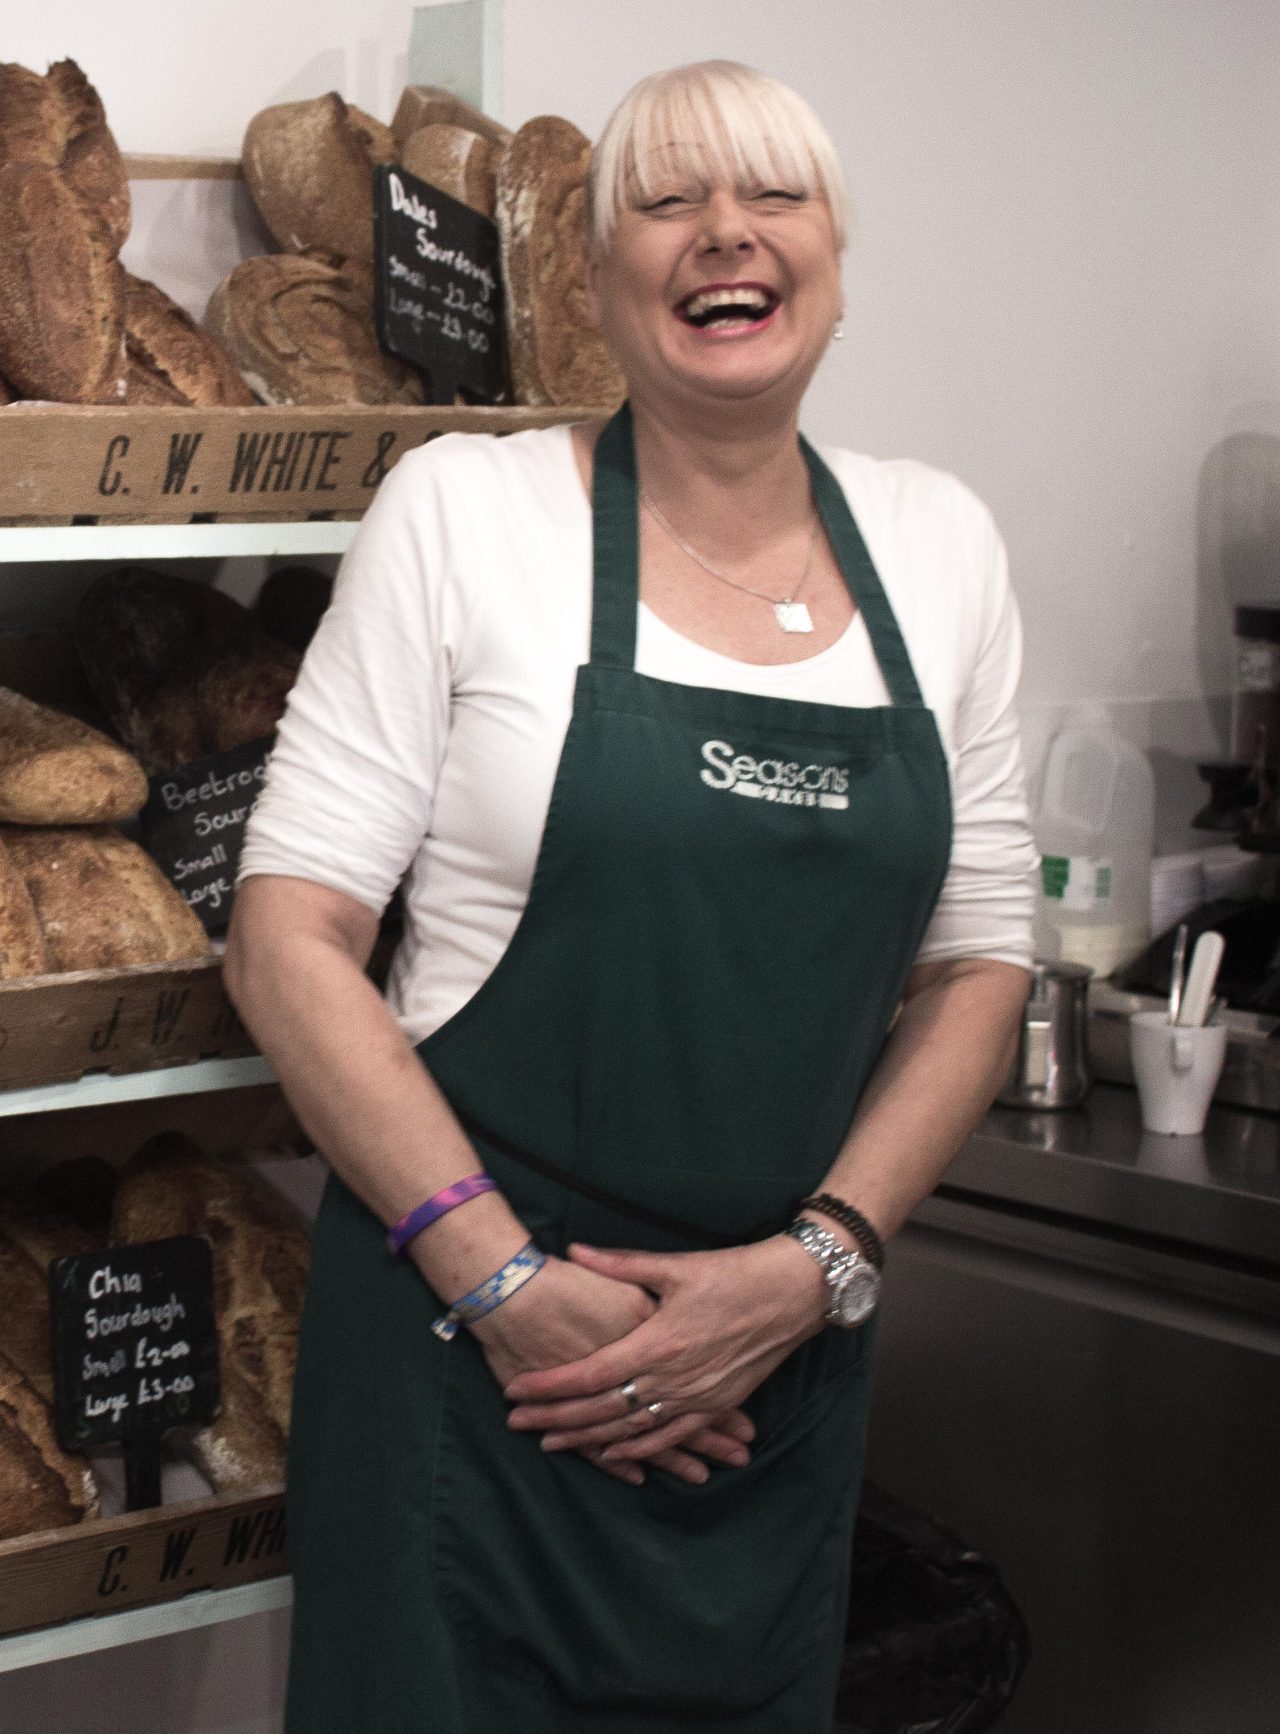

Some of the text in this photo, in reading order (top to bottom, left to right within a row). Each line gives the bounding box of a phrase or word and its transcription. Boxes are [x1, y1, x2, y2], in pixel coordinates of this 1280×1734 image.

[98, 431, 396, 496] C. W. WHITE &
[700, 739, 850, 793] Seasons
[173, 843, 228, 880] Small
[89, 1264, 142, 1299] Chia
[84, 1292, 186, 1340] Sourdough
[85, 1393, 130, 1423] Large
